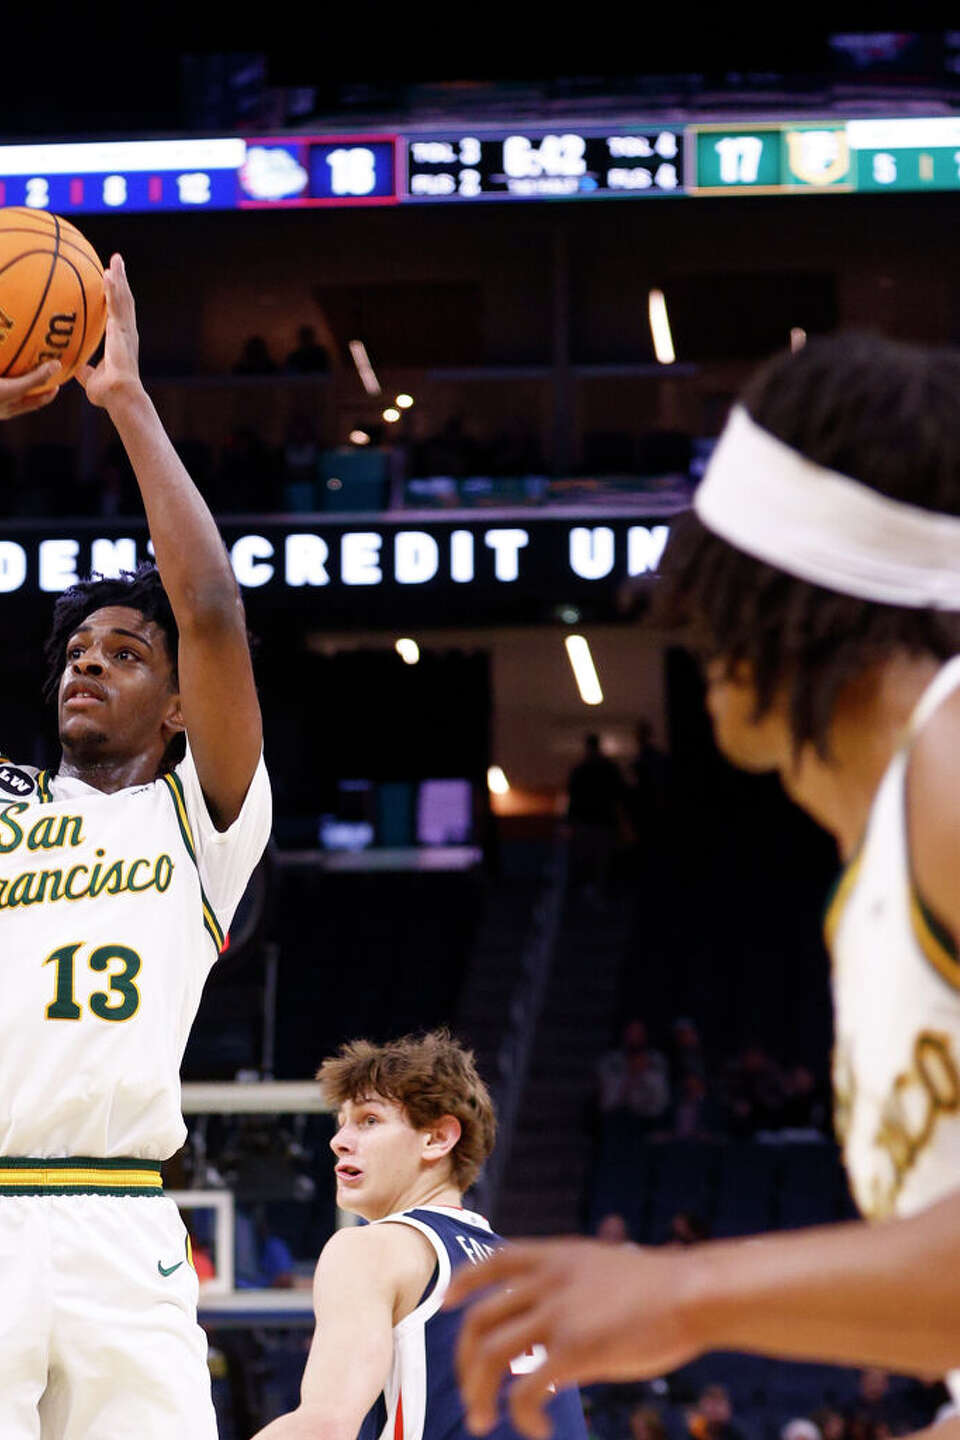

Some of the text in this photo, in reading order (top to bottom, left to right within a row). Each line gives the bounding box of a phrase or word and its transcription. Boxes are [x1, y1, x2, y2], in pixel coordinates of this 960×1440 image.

[714, 136, 763, 184] 17
[230, 528, 529, 588] CREDIT
[41, 941, 142, 1022] 13
